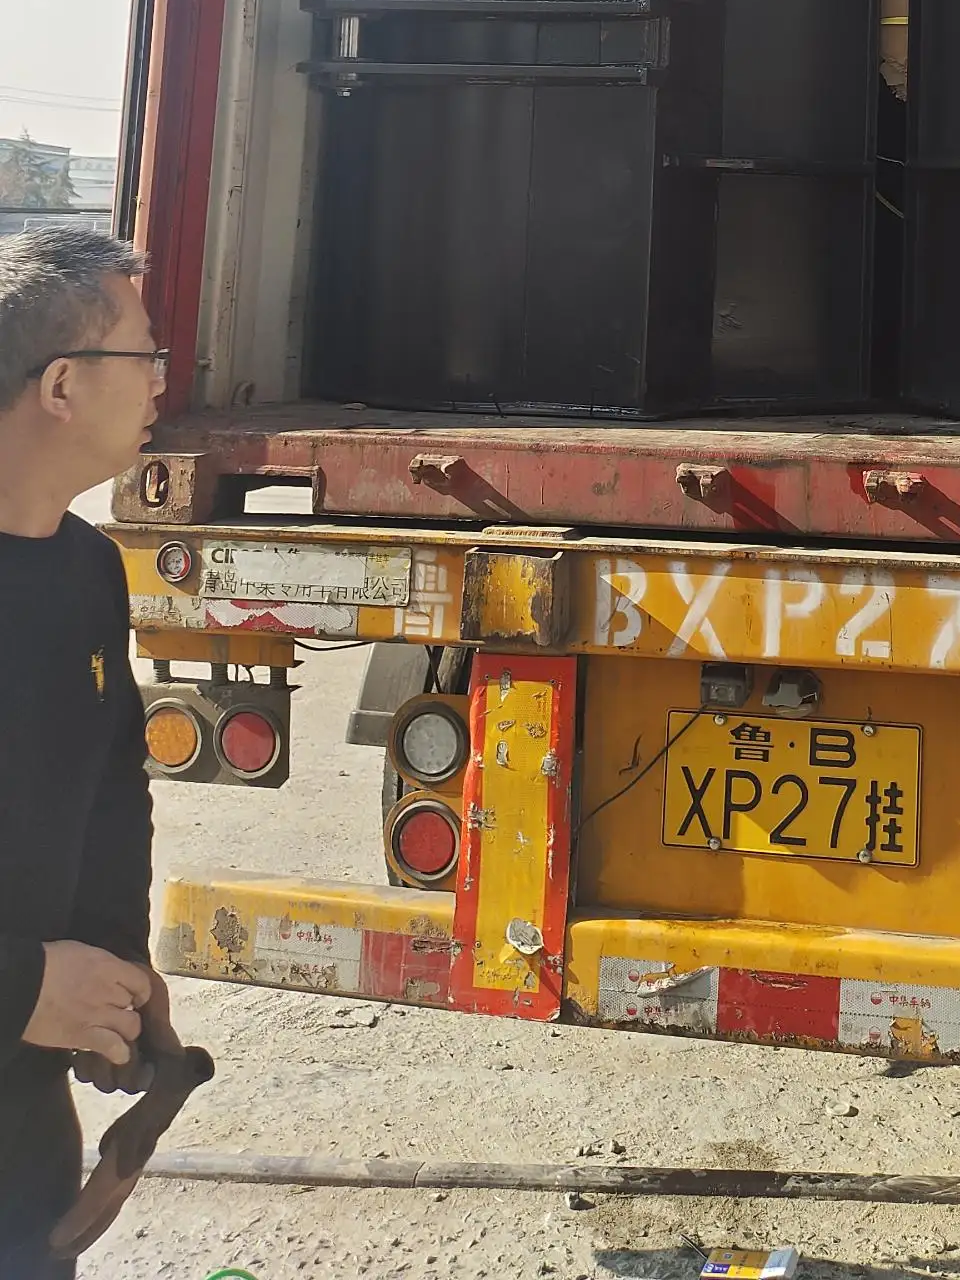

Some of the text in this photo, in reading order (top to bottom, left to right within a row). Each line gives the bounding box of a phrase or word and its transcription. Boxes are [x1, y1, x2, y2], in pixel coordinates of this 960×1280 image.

[676, 765, 904, 853] XP27挂
[888, 993, 932, 1010] 中集车辆
